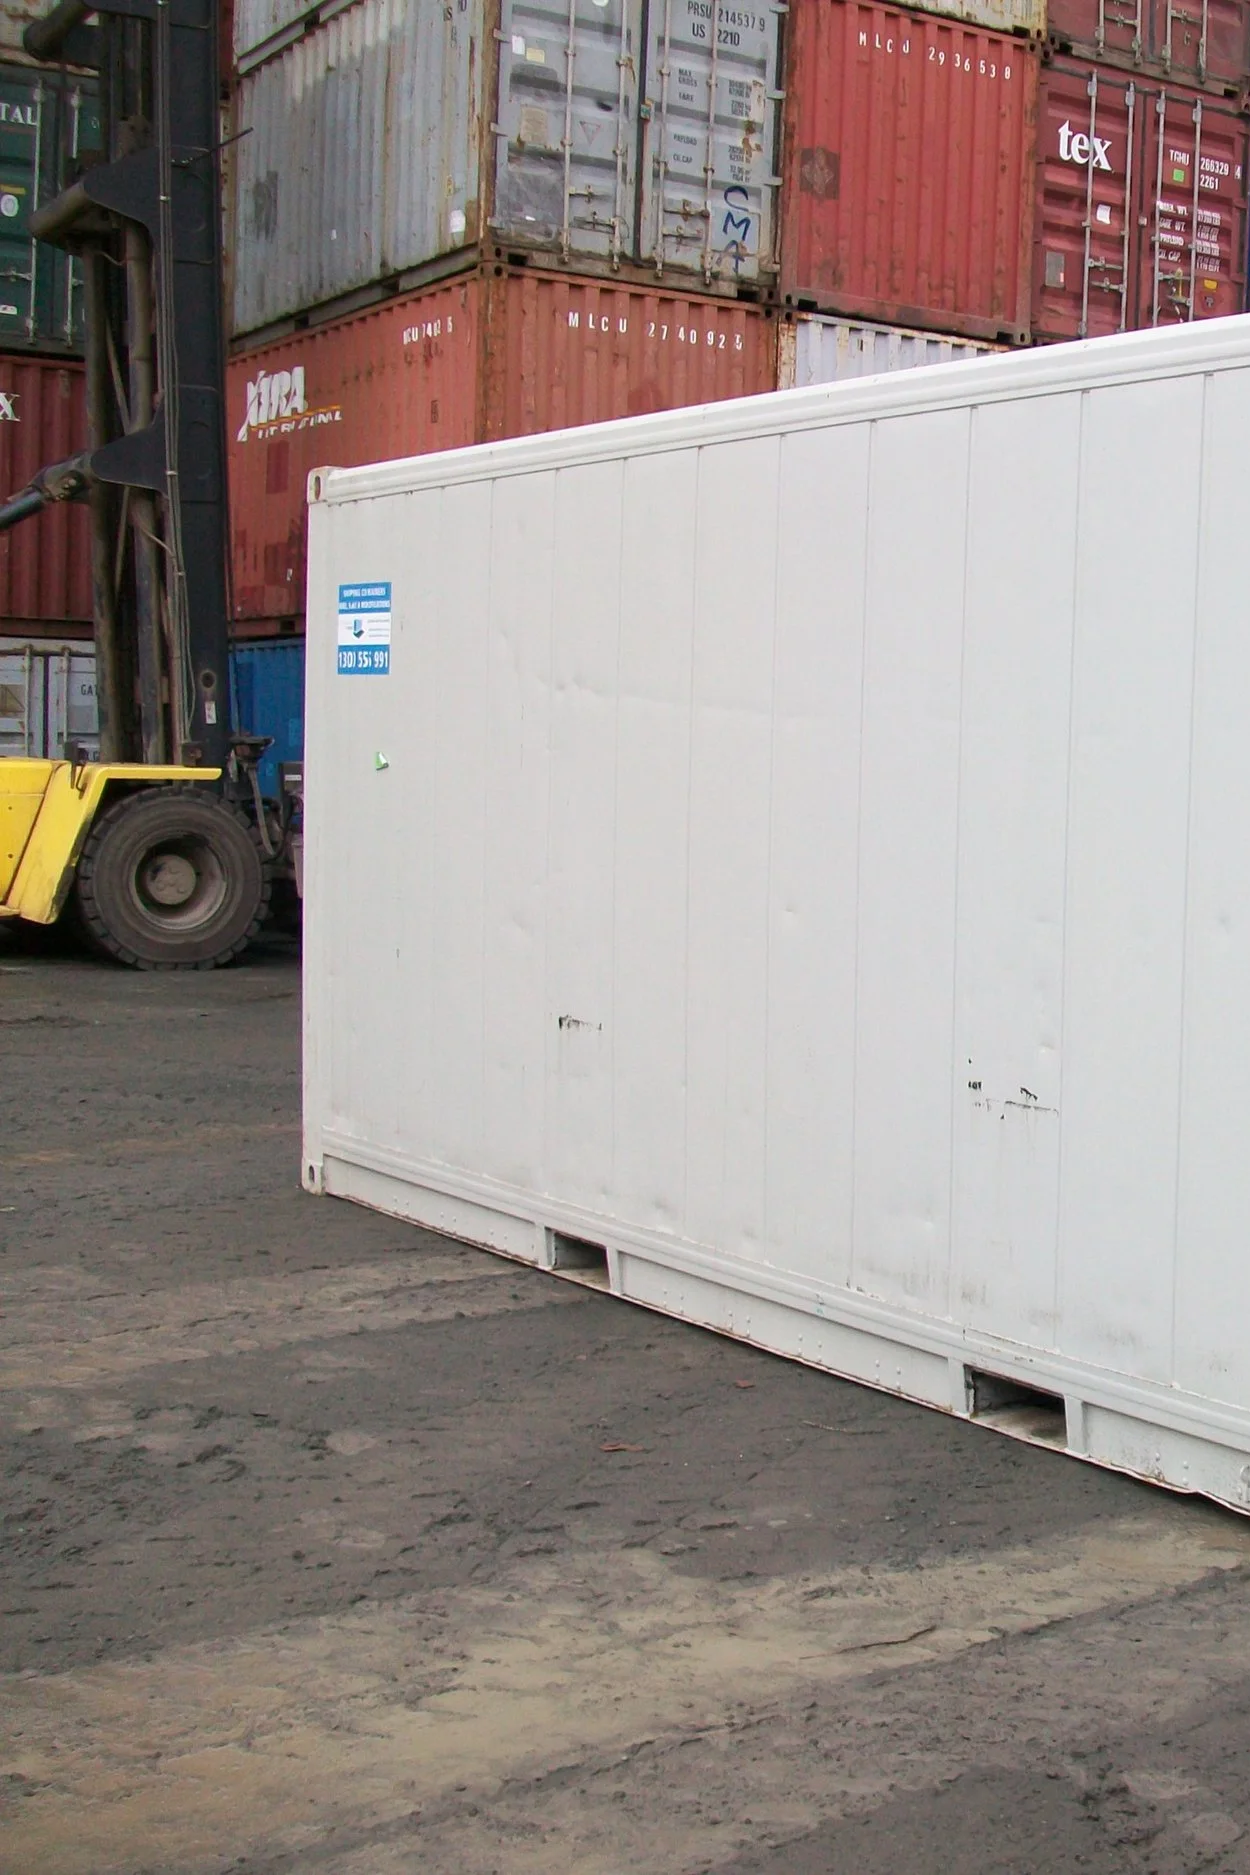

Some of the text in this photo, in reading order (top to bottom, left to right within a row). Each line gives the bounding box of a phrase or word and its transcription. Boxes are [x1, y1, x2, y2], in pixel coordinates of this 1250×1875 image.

[687, 1, 713, 19] PRSU
[692, 22, 740, 46] US 2210
[1058, 119, 1112, 171] tex
[568, 311, 628, 333] MLCU
